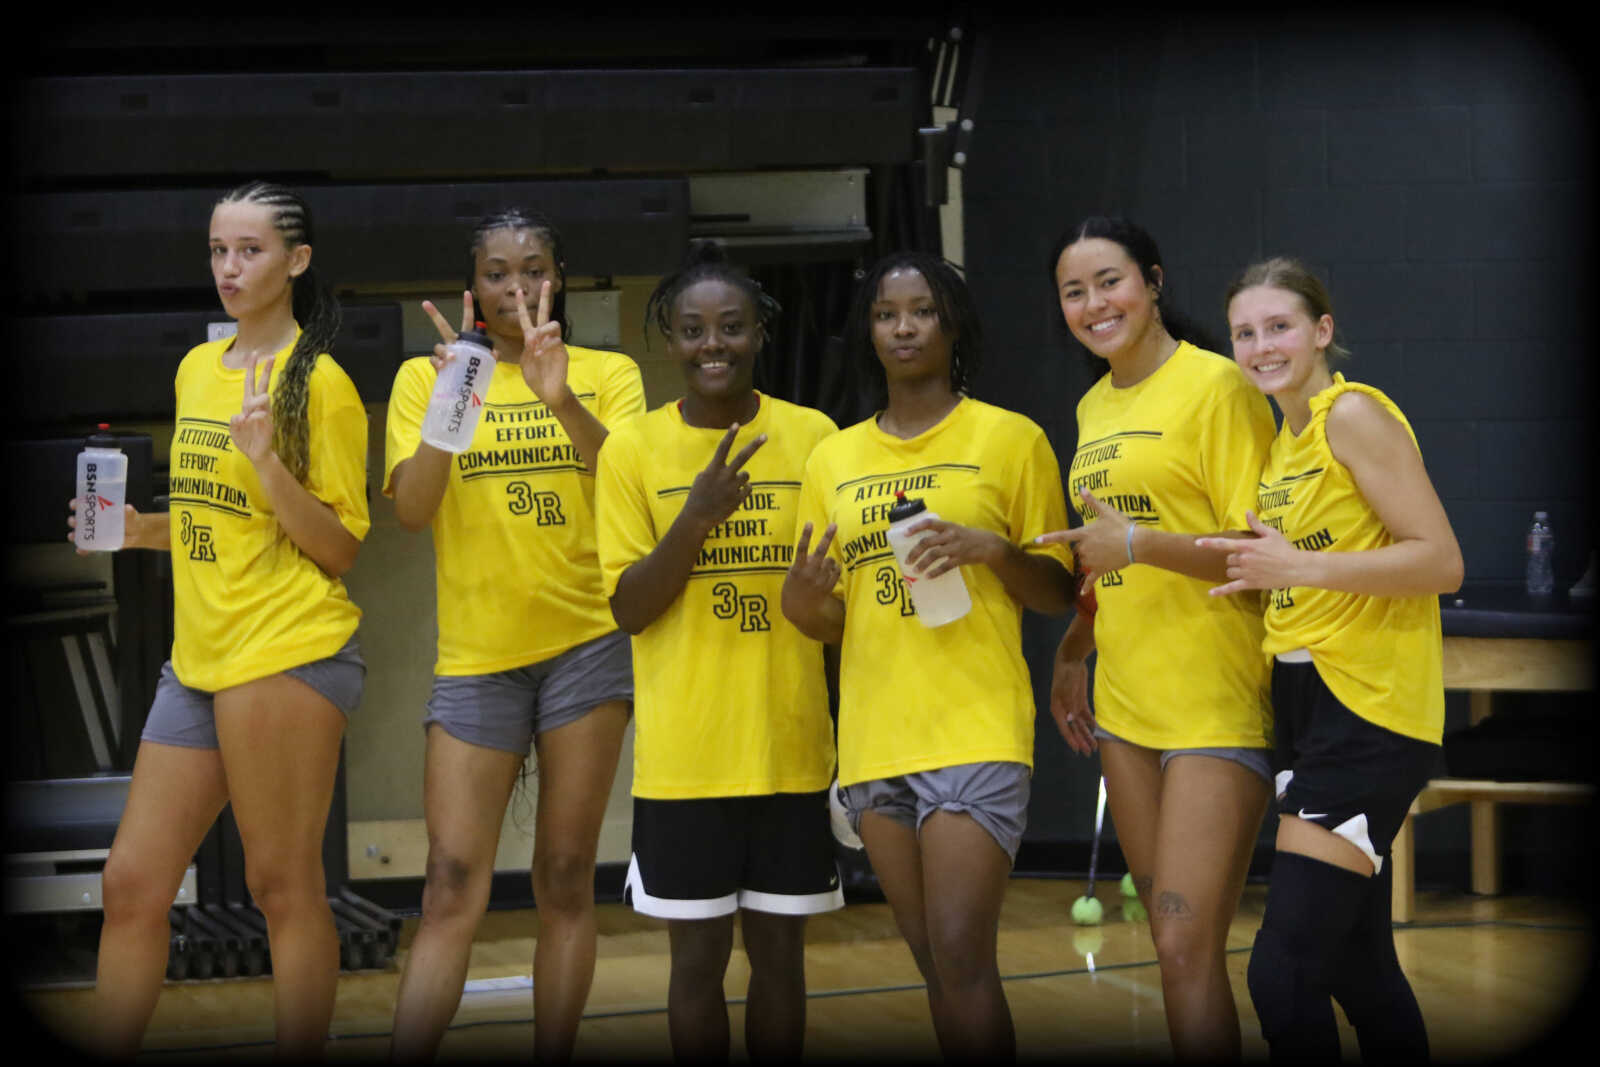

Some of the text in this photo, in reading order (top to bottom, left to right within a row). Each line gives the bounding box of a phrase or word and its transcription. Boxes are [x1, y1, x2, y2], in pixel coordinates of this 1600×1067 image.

[448, 356, 481, 434] BSN SPORTS
[496, 423, 563, 442] EFFORT.
[180, 452, 219, 473] EFFORT.
[84, 462, 98, 541] BSN SPORTS
[506, 481, 566, 526] 3R
[855, 473, 942, 502] ATTITUDE.
[180, 511, 216, 562] 3R
[705, 518, 773, 539] FFORT.
[712, 582, 771, 633] 3R
